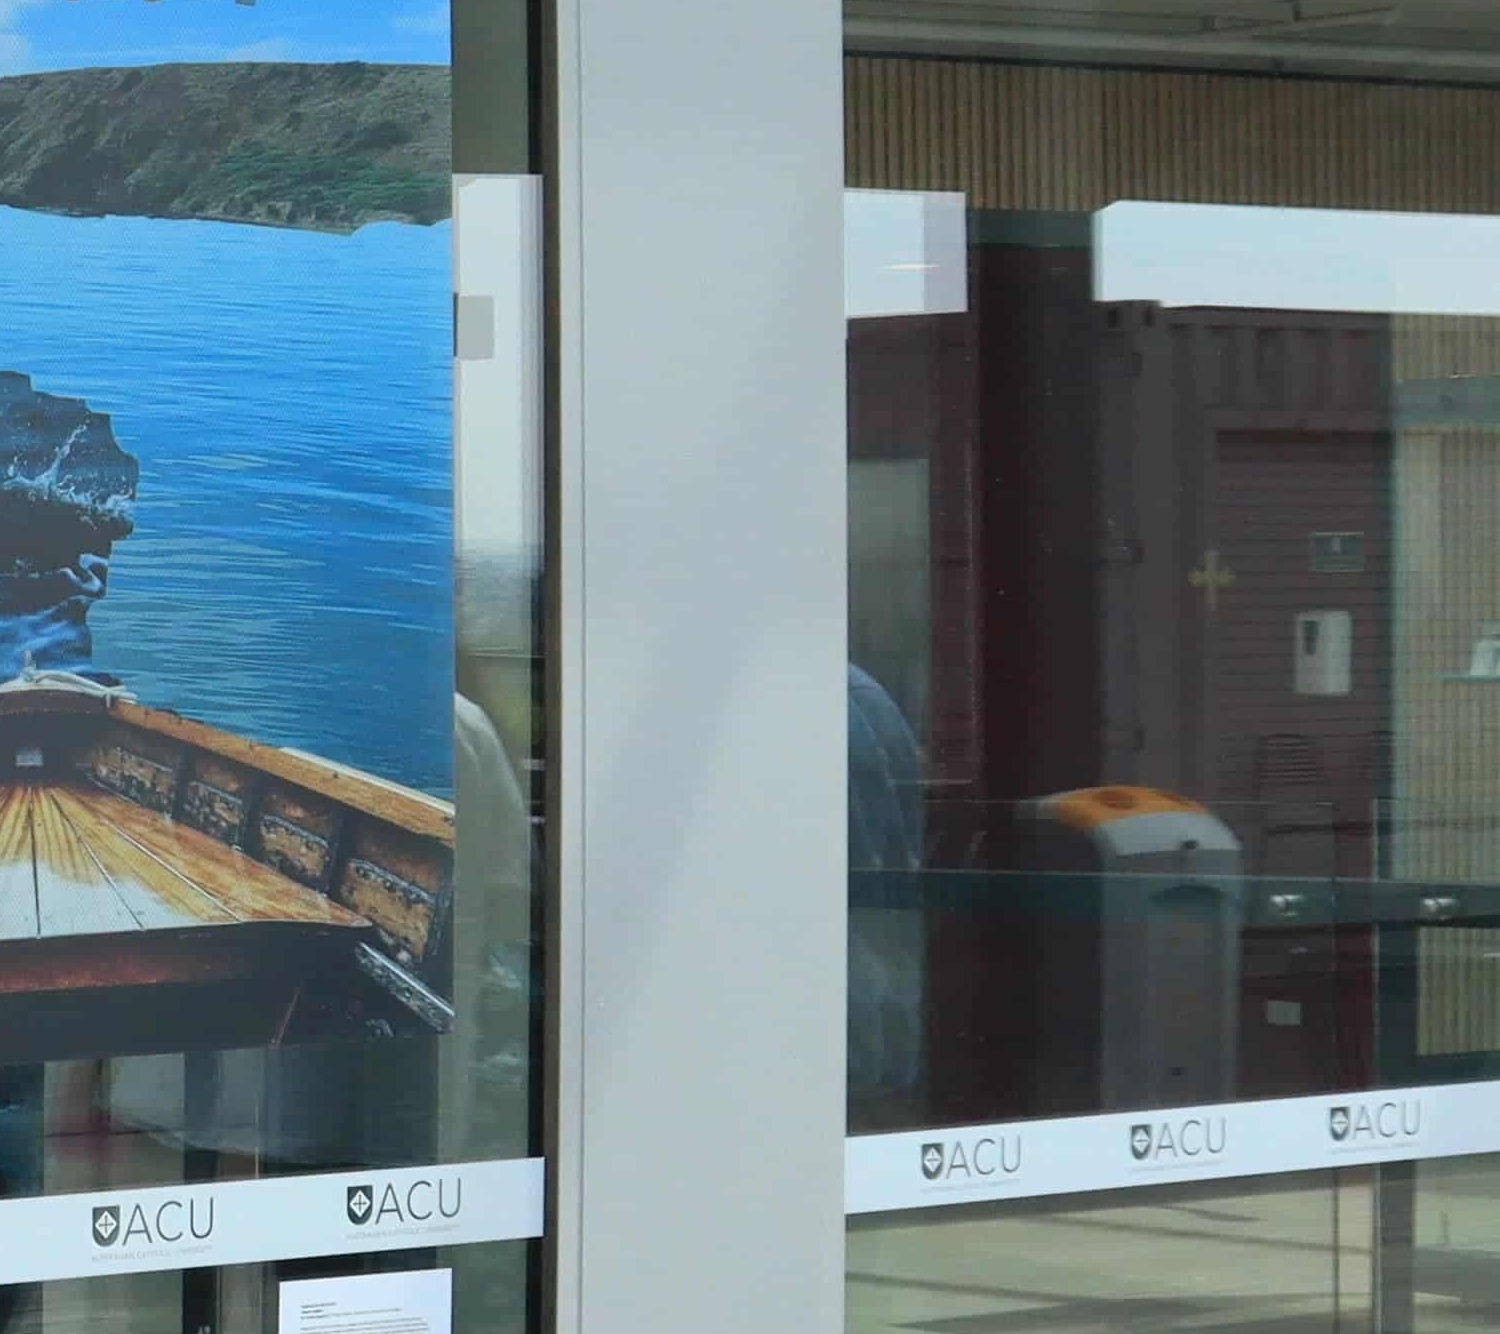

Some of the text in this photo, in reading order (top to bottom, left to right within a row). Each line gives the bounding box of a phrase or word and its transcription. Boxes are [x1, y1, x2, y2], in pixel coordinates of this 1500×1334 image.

[1155, 1116, 1226, 1159] ACU
[1352, 1100, 1421, 1140] ACU
[946, 1135, 1021, 1179] ACU
[122, 1197, 214, 1246] ACU
[375, 1177, 461, 1225] ACU
